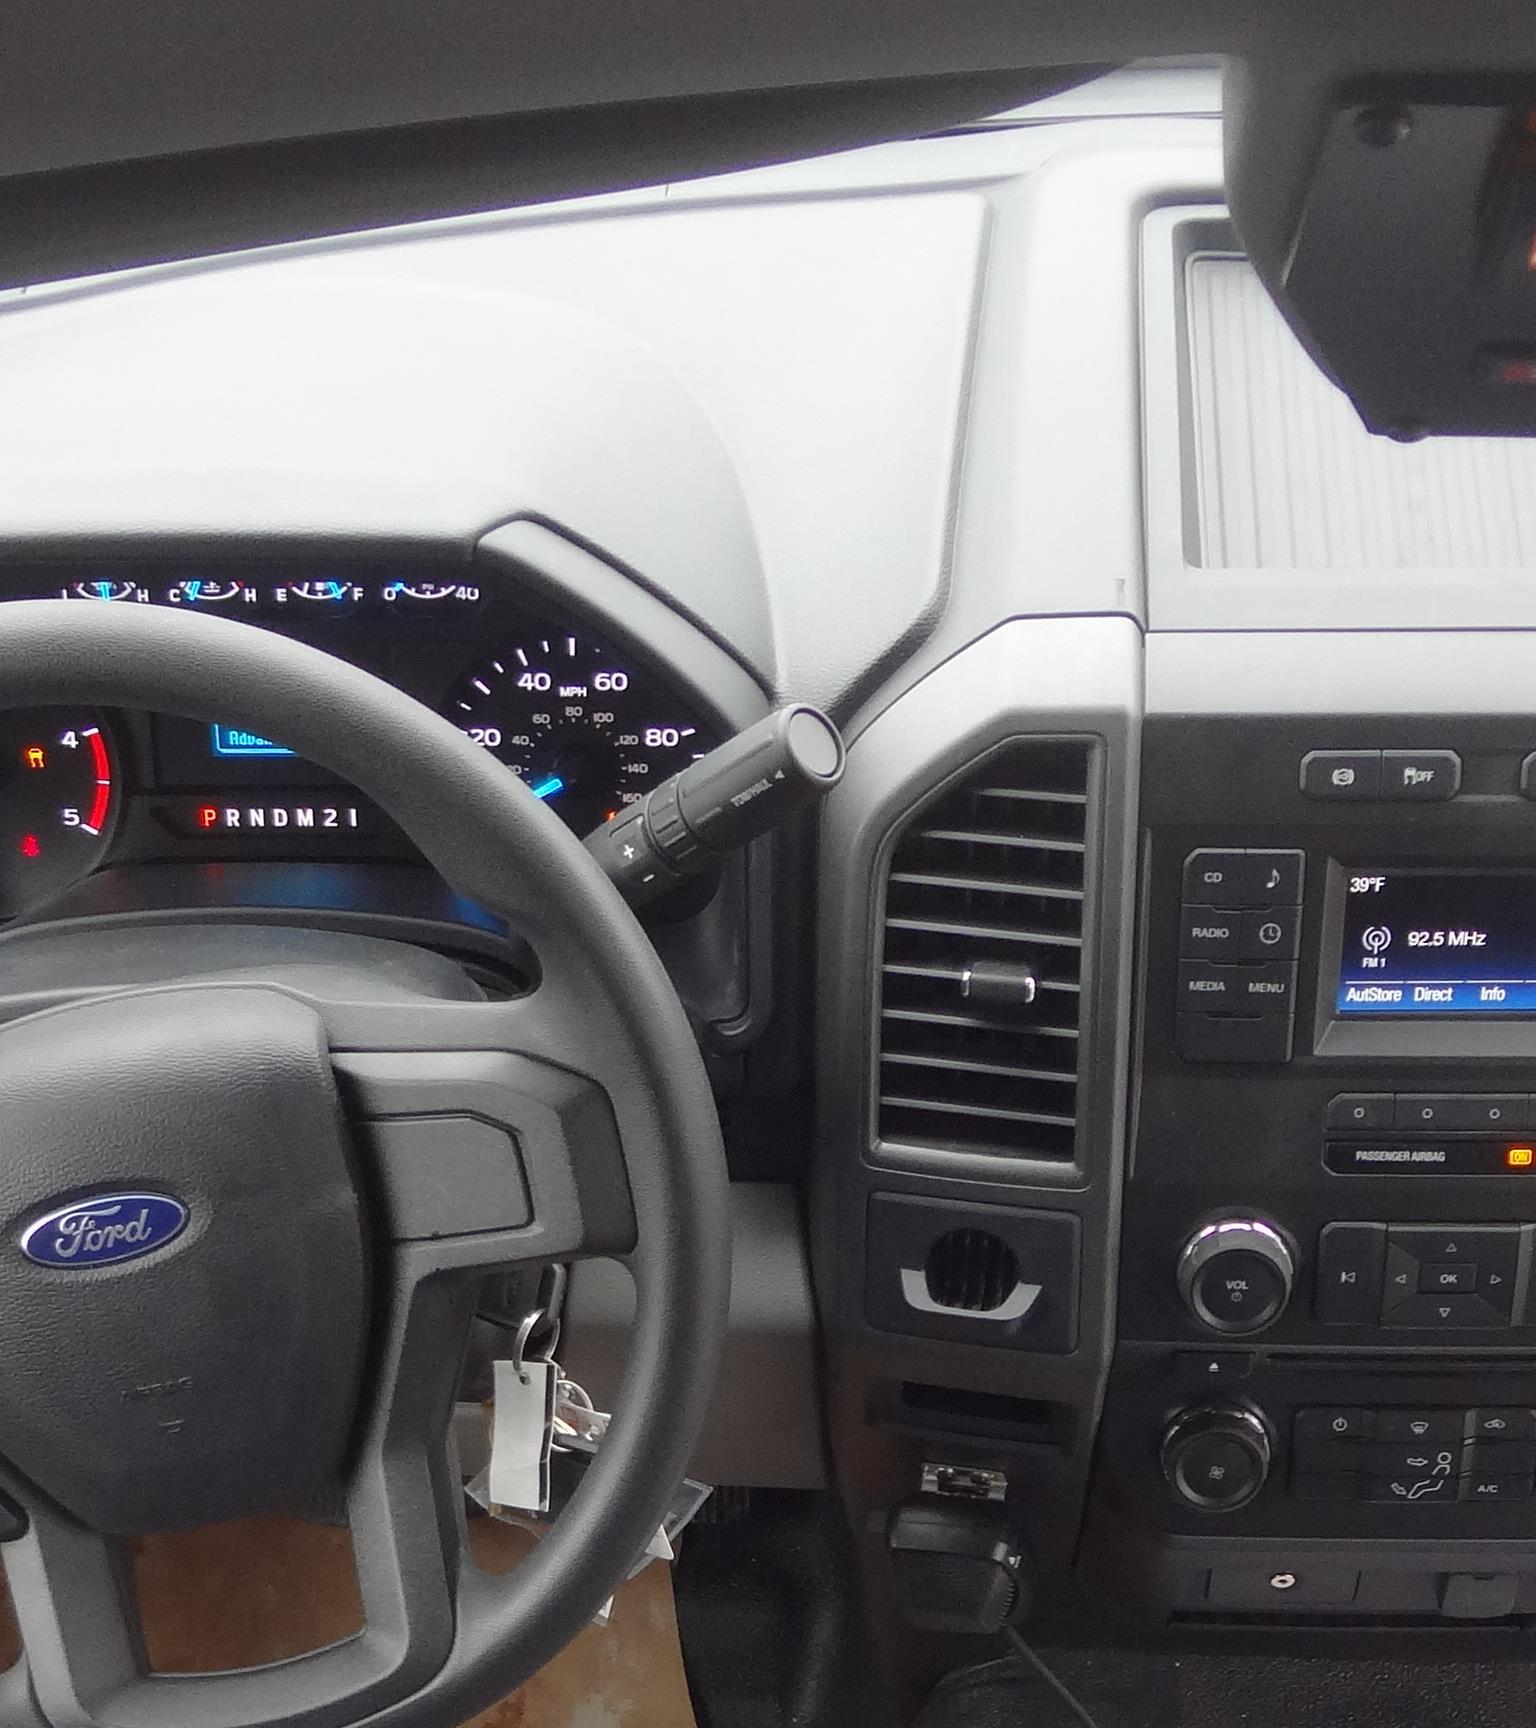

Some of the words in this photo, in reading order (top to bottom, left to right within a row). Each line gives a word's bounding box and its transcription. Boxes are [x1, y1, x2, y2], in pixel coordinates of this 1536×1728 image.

[517, 672, 551, 691] 40
[594, 672, 628, 691] 60
[559, 686, 587, 698] MPH
[565, 706, 583, 717] 80
[532, 714, 550, 724] 60
[593, 712, 614, 723] 100
[62, 732, 79, 748] 4
[470, 728, 502, 747] 20
[511, 735, 529, 746] 40
[619, 735, 639, 745] 120
[645, 728, 679, 747] 80
[64, 809, 80, 826] 5
[1204, 872, 1223, 883] CD
[1192, 928, 1230, 938] RADIO
[1407, 931, 1445, 947] 92.5
[1448, 931, 1487, 947] MHz
[1362, 957, 1379, 968] FM
[1189, 981, 1226, 991] MEDIA
[1248, 982, 1285, 993] MENU
[1346, 987, 1402, 1002] AutStore
[1414, 986, 1453, 1002] Direct
[1480, 986, 1506, 1001] Info
[1356, 1151, 1410, 1162] PASSENGER
[1411, 1151, 1446, 1162] AIRBAG
[55, 1204, 153, 1258] Ford
[1440, 1274, 1458, 1284] OK
[1225, 1280, 1250, 1291] VOL
[1477, 1484, 1498, 1493] A/C
